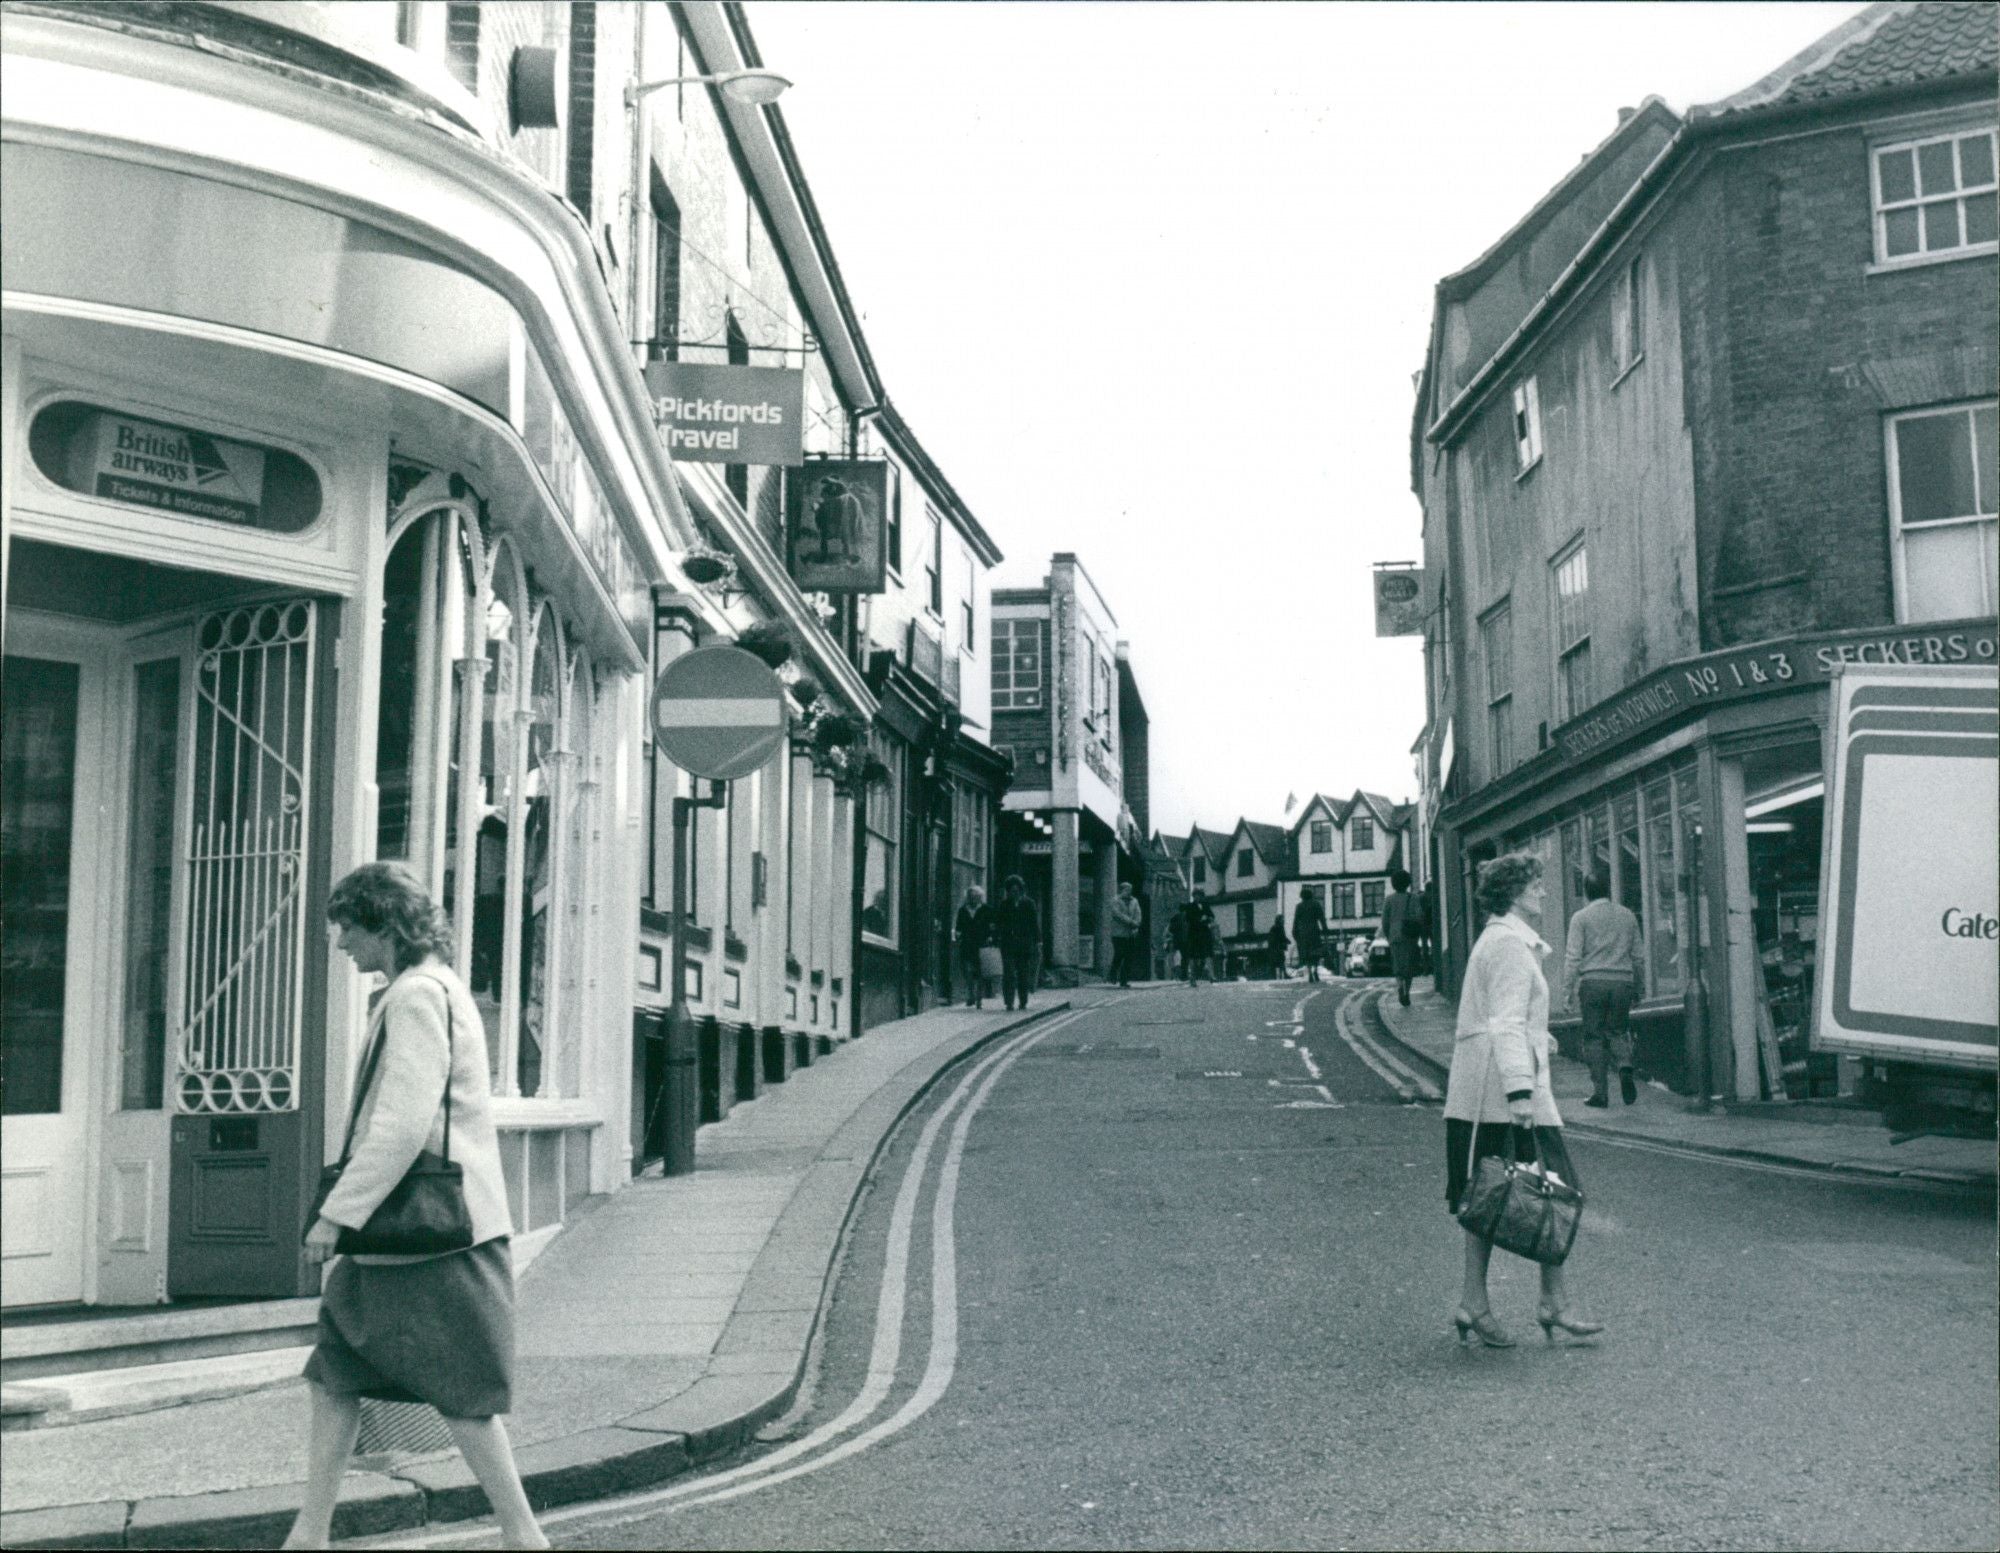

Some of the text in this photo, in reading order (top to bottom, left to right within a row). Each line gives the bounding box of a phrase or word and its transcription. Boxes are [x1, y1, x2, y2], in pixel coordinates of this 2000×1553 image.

[660, 397, 782, 424] Pickfords
[117, 425, 190, 461] British
[659, 424, 738, 449] Travel
[112, 451, 188, 482] airways
[111, 480, 158, 504] Tickets
[161, 492, 171, 504] &
[1750, 660, 1769, 683] &
[1769, 652, 1793, 679] 3
[1816, 634, 1968, 672] SECKERS
[1616, 680, 1679, 728] NORWICH
